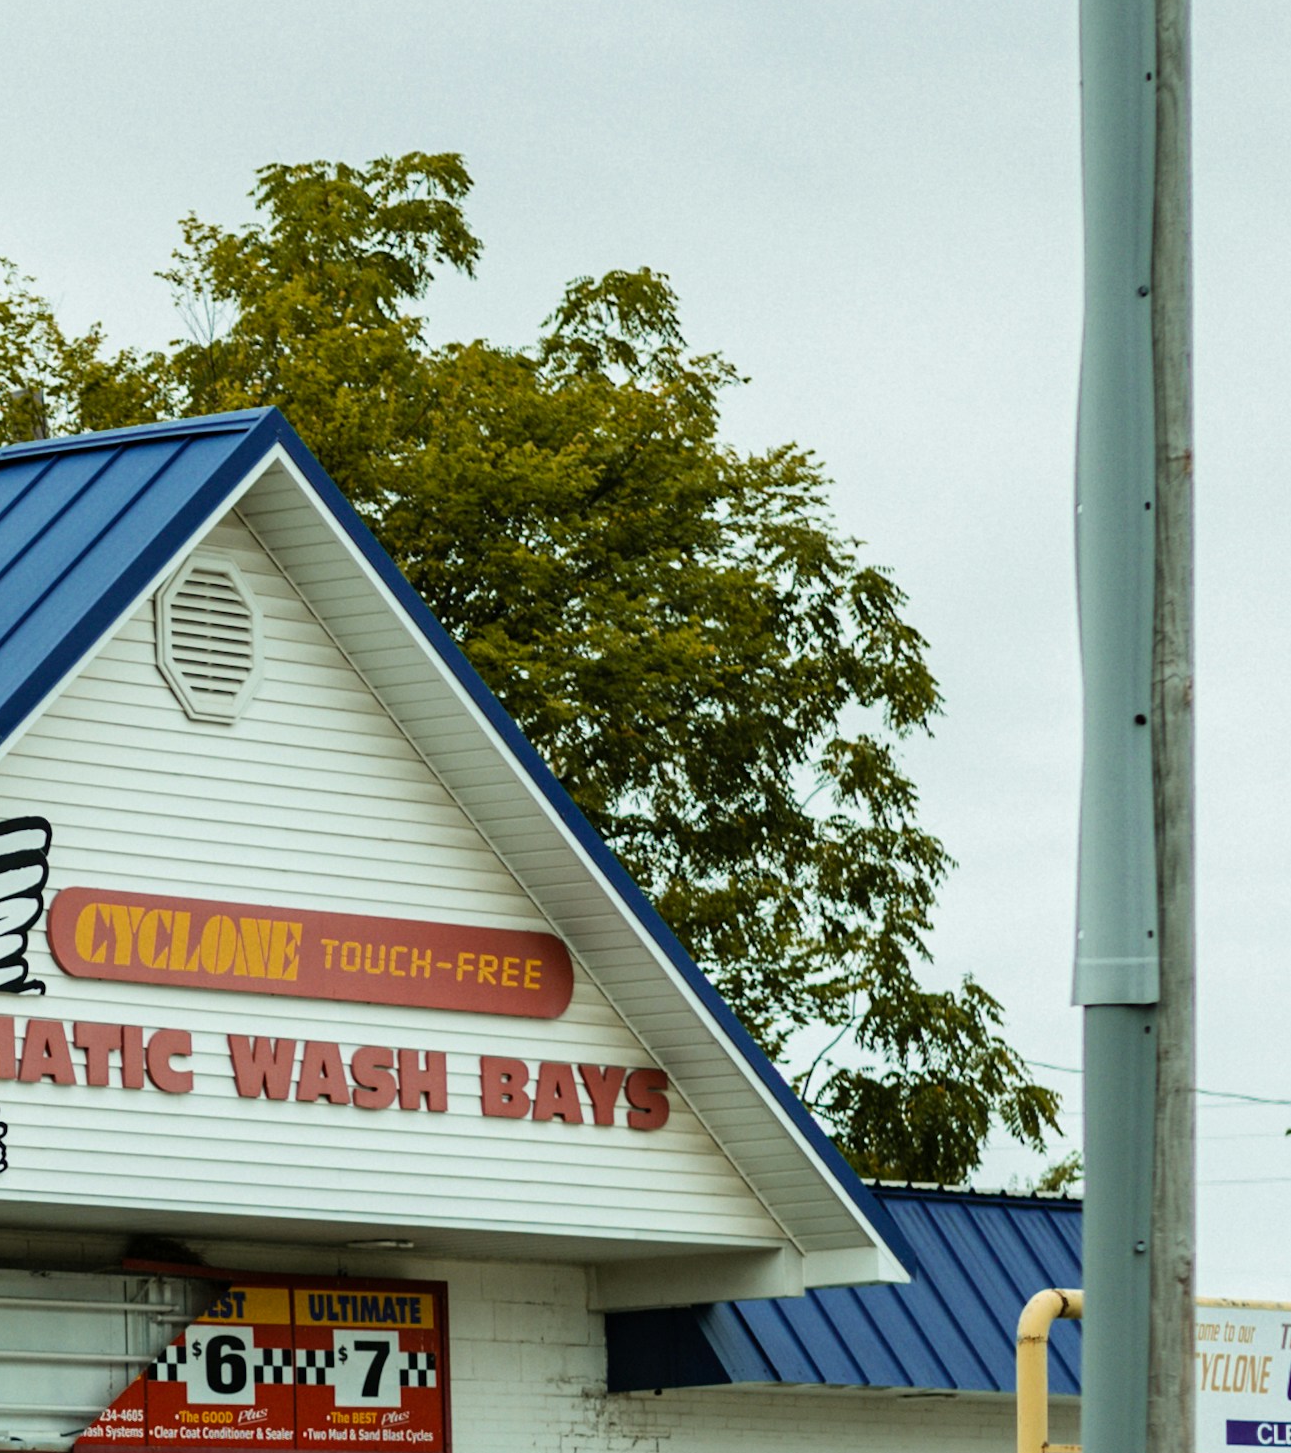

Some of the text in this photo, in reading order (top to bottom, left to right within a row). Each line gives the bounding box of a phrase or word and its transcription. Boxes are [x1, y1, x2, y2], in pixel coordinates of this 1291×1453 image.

[74, 902, 543, 990] CYCLONE TOUCH-FREE
[227, 1034, 448, 1112] WASH
[480, 1055, 670, 1131] BAYS
[308, 1294, 422, 1324] ULTIMATE
[1195, 1321, 1256, 1343] ome to our
[1195, 1352, 1272, 1394] YCLONE
[179, 1410, 199, 1423] The
[202, 1411, 233, 1424] GOOD
[330, 1412, 349, 1424] The
[352, 1412, 378, 1424] BEST
[106, 1425, 144, 1440] Systems
[153, 1426, 294, 1441] Clear Coat Conditioner & Sealer
[307, 1428, 433, 1444] Two Mud & Sand Blast Cycles
